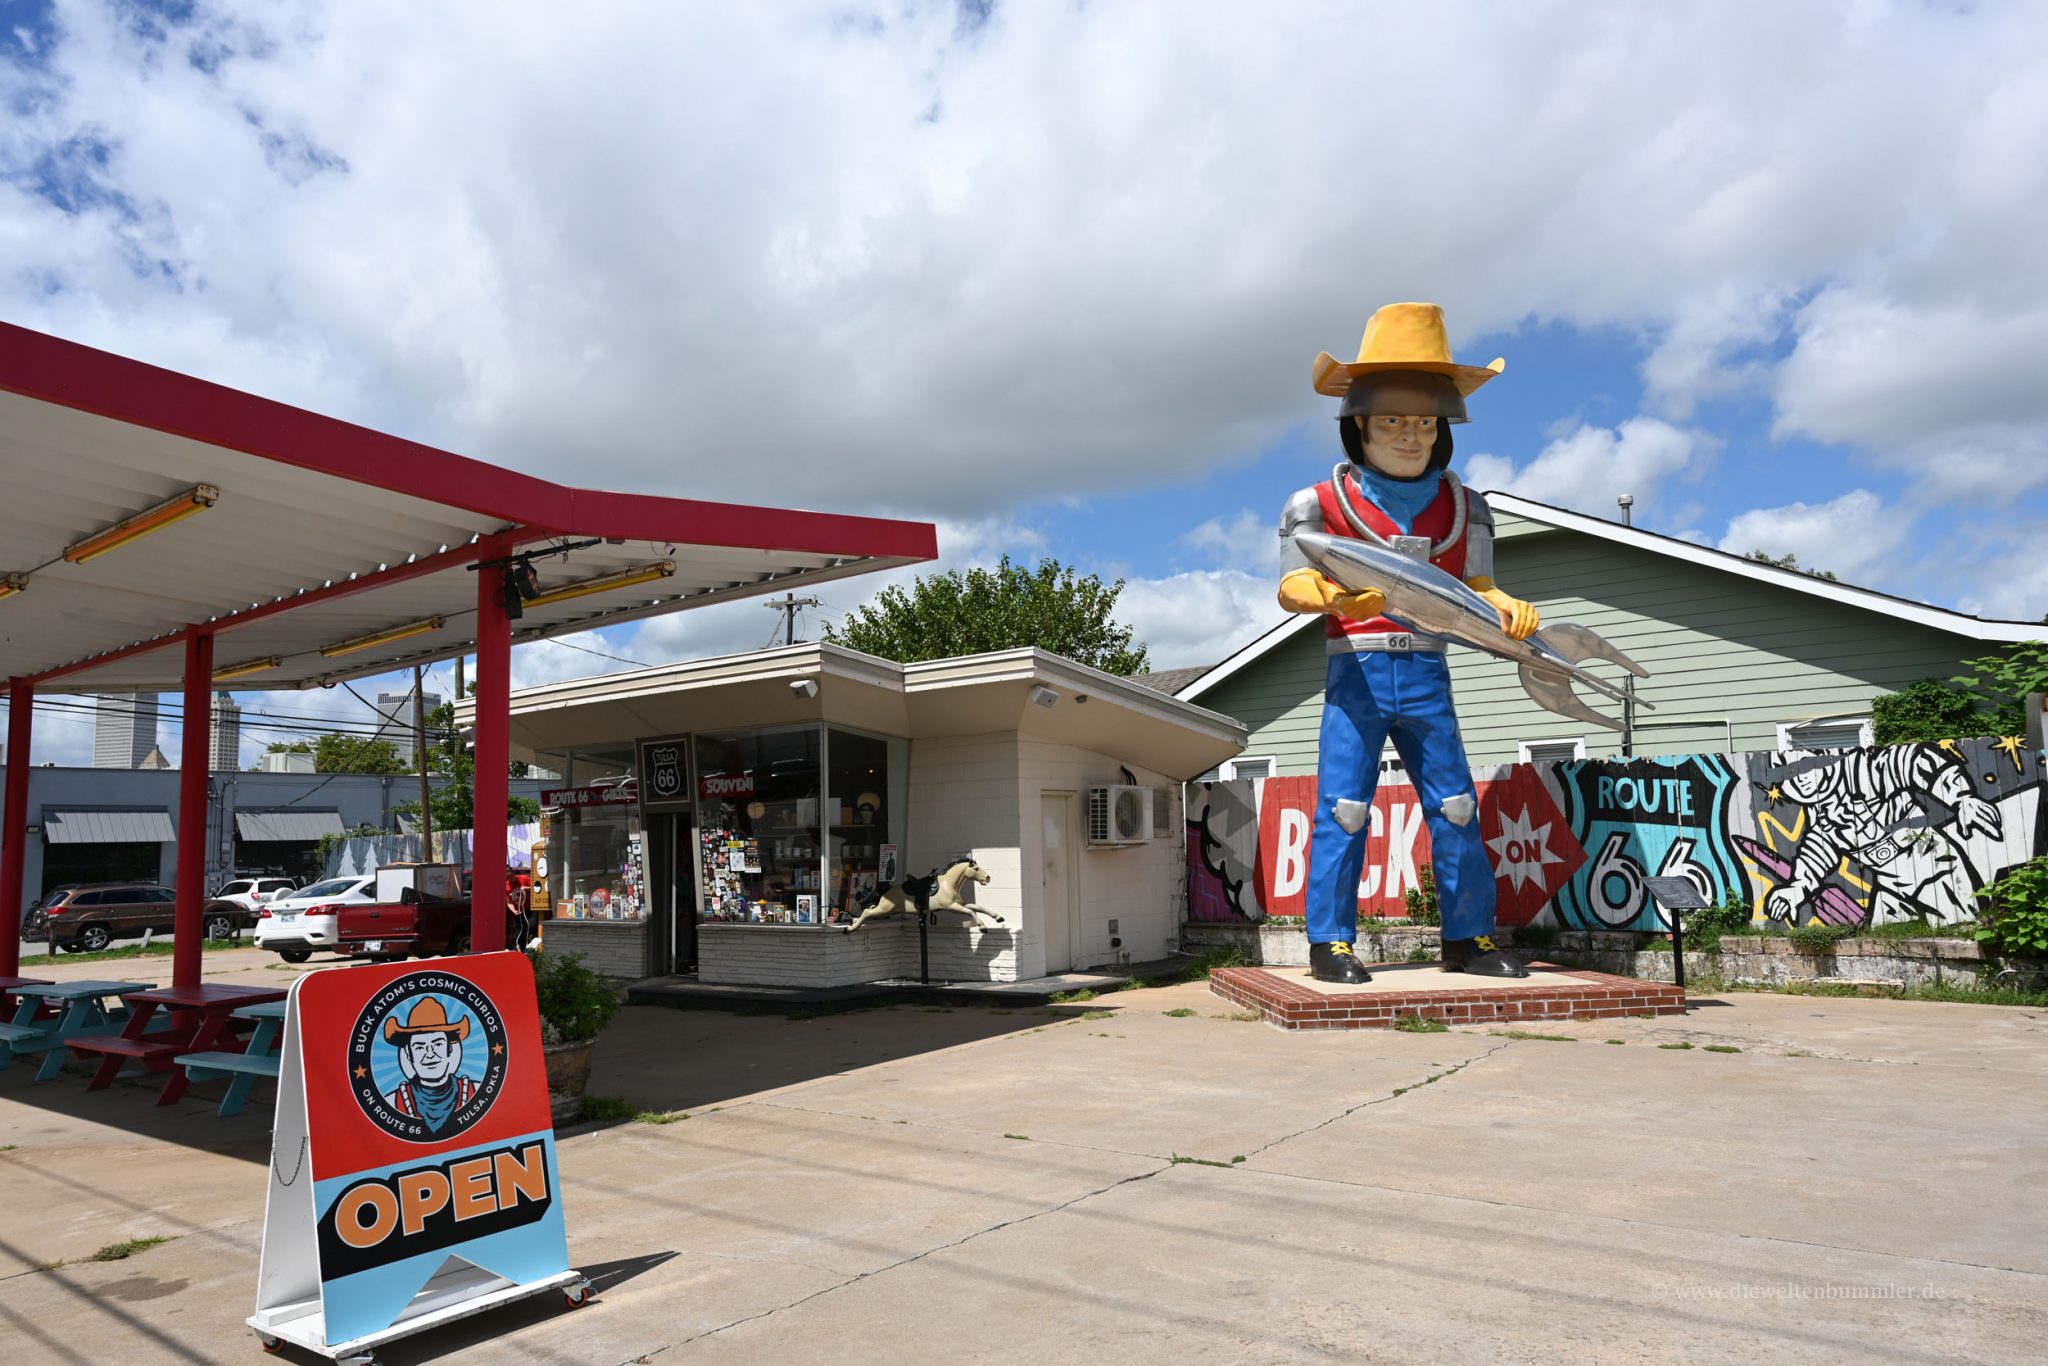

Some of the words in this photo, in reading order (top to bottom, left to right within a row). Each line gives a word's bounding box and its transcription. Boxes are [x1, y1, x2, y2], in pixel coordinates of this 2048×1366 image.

[1388, 636, 1407, 648] 66
[656, 752, 675, 762] TULSA
[657, 768, 675, 788] 66
[550, 790, 577, 805] ROUTE
[578, 790, 589, 803] 66
[1598, 776, 1695, 816] ROUTE
[1274, 803, 1424, 899] BCK
[1505, 839, 1543, 864] ON
[355, 1016, 376, 1053] BUCK
[374, 980, 416, 1015] ATOM'S
[419, 977, 467, 995] COSMIC
[468, 992, 499, 1034] CURIOS
[362, 1088, 376, 1107] ON
[374, 1107, 407, 1131] ROUTE
[408, 1126, 422, 1135] 66
[457, 1097, 489, 1125] TULSA,
[486, 1065, 501, 1094] OKLA
[334, 1144, 548, 1249] OPEN
